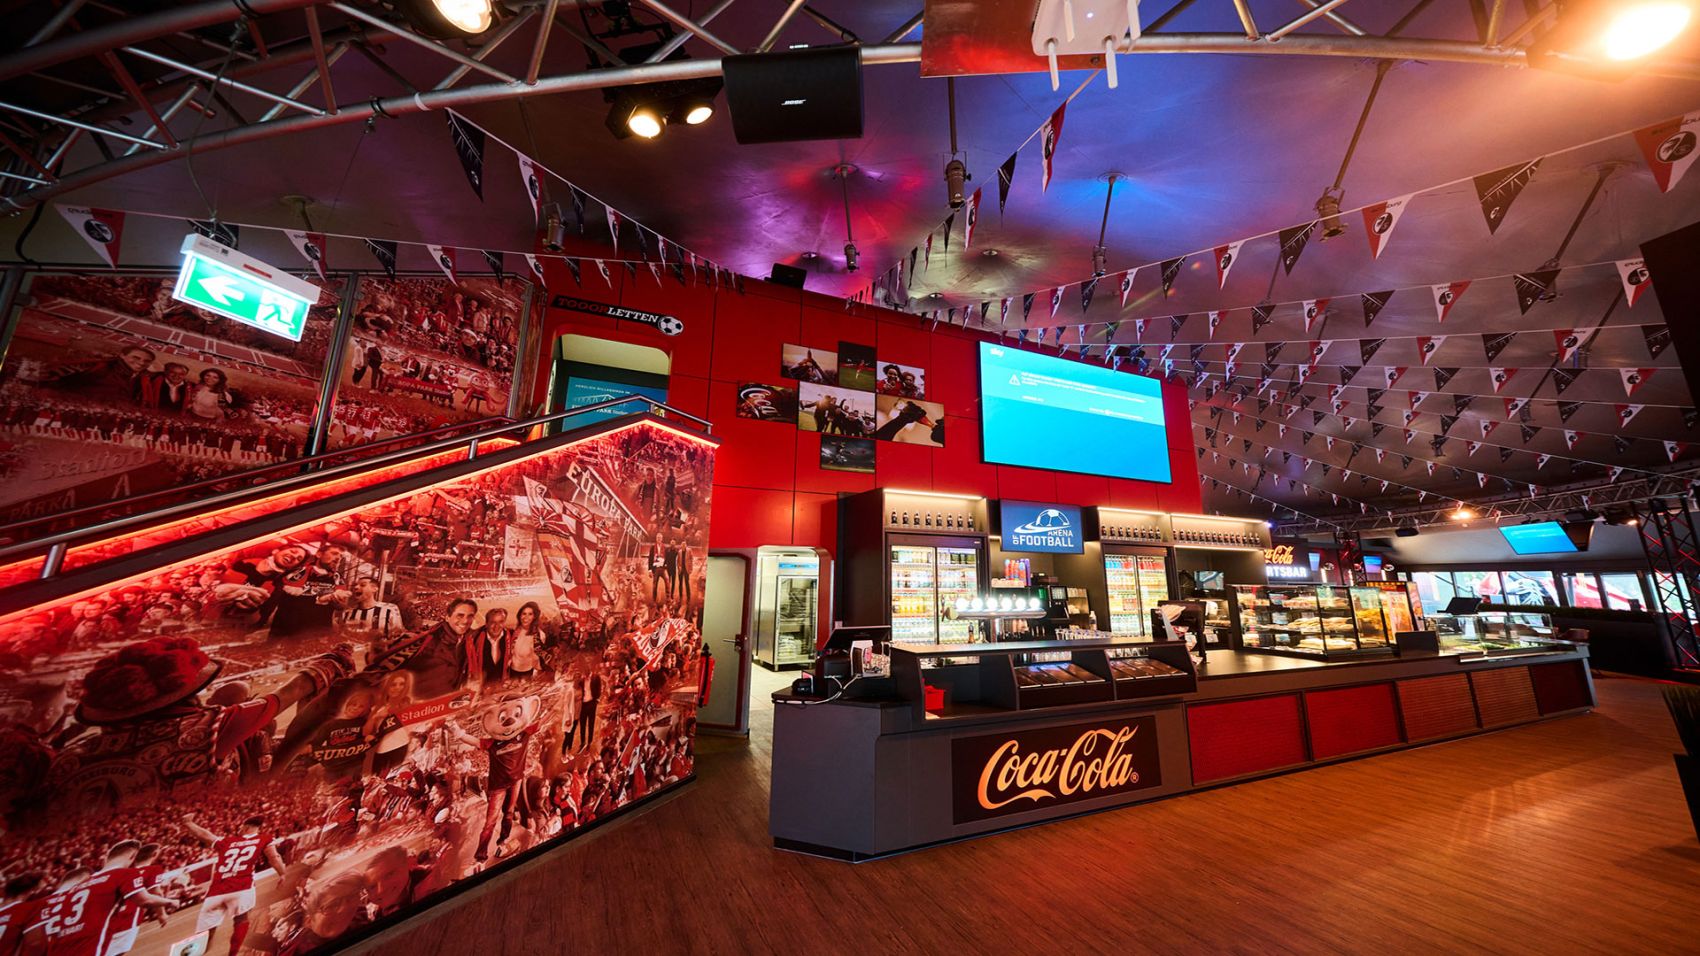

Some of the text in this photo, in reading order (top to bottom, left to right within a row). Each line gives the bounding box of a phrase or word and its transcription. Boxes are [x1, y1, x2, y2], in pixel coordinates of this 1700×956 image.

[1020, 535, 1075, 547] FOOTBALL
[1047, 529, 1074, 537] ARENA
[400, 703, 446, 722] Stadion
[977, 725, 1139, 810] Coca-Cola
[218, 845, 257, 873] 32
